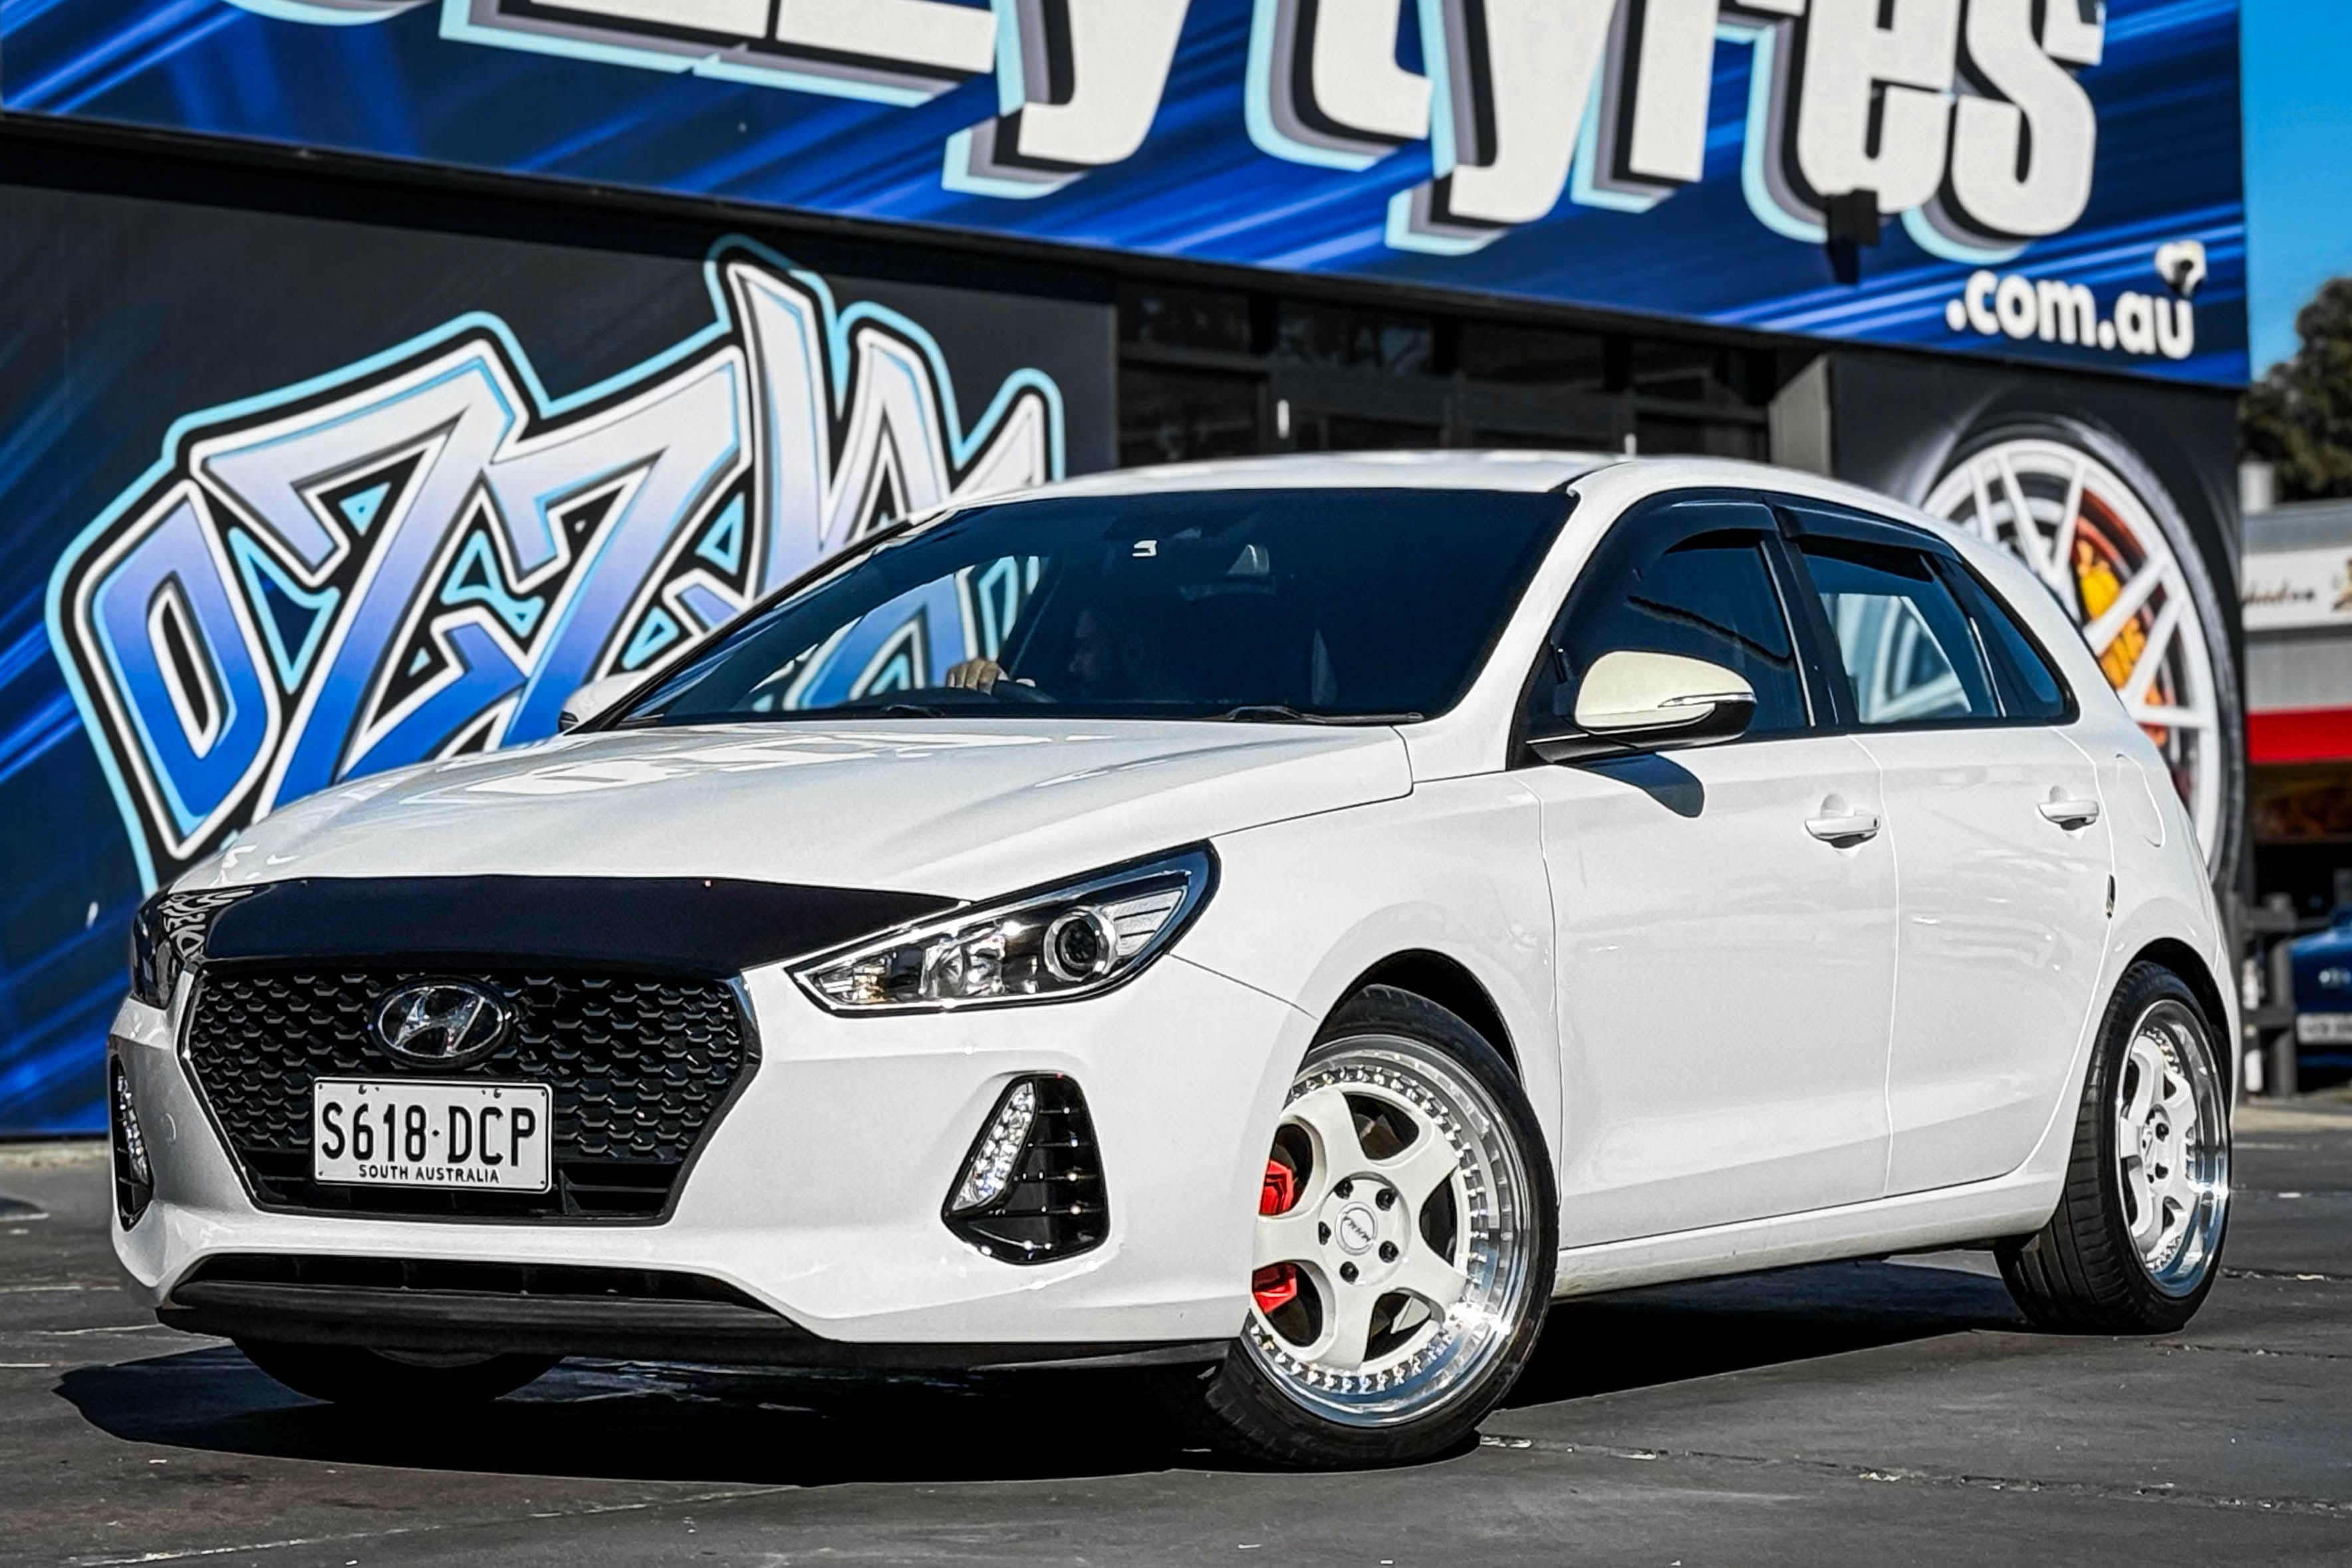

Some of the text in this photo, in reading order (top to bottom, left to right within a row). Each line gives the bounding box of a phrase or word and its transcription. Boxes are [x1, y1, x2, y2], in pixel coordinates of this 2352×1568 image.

[1945, 269, 2194, 360] .com.au
[358, 1164, 500, 1184] SOUTH AUSTRALIA
